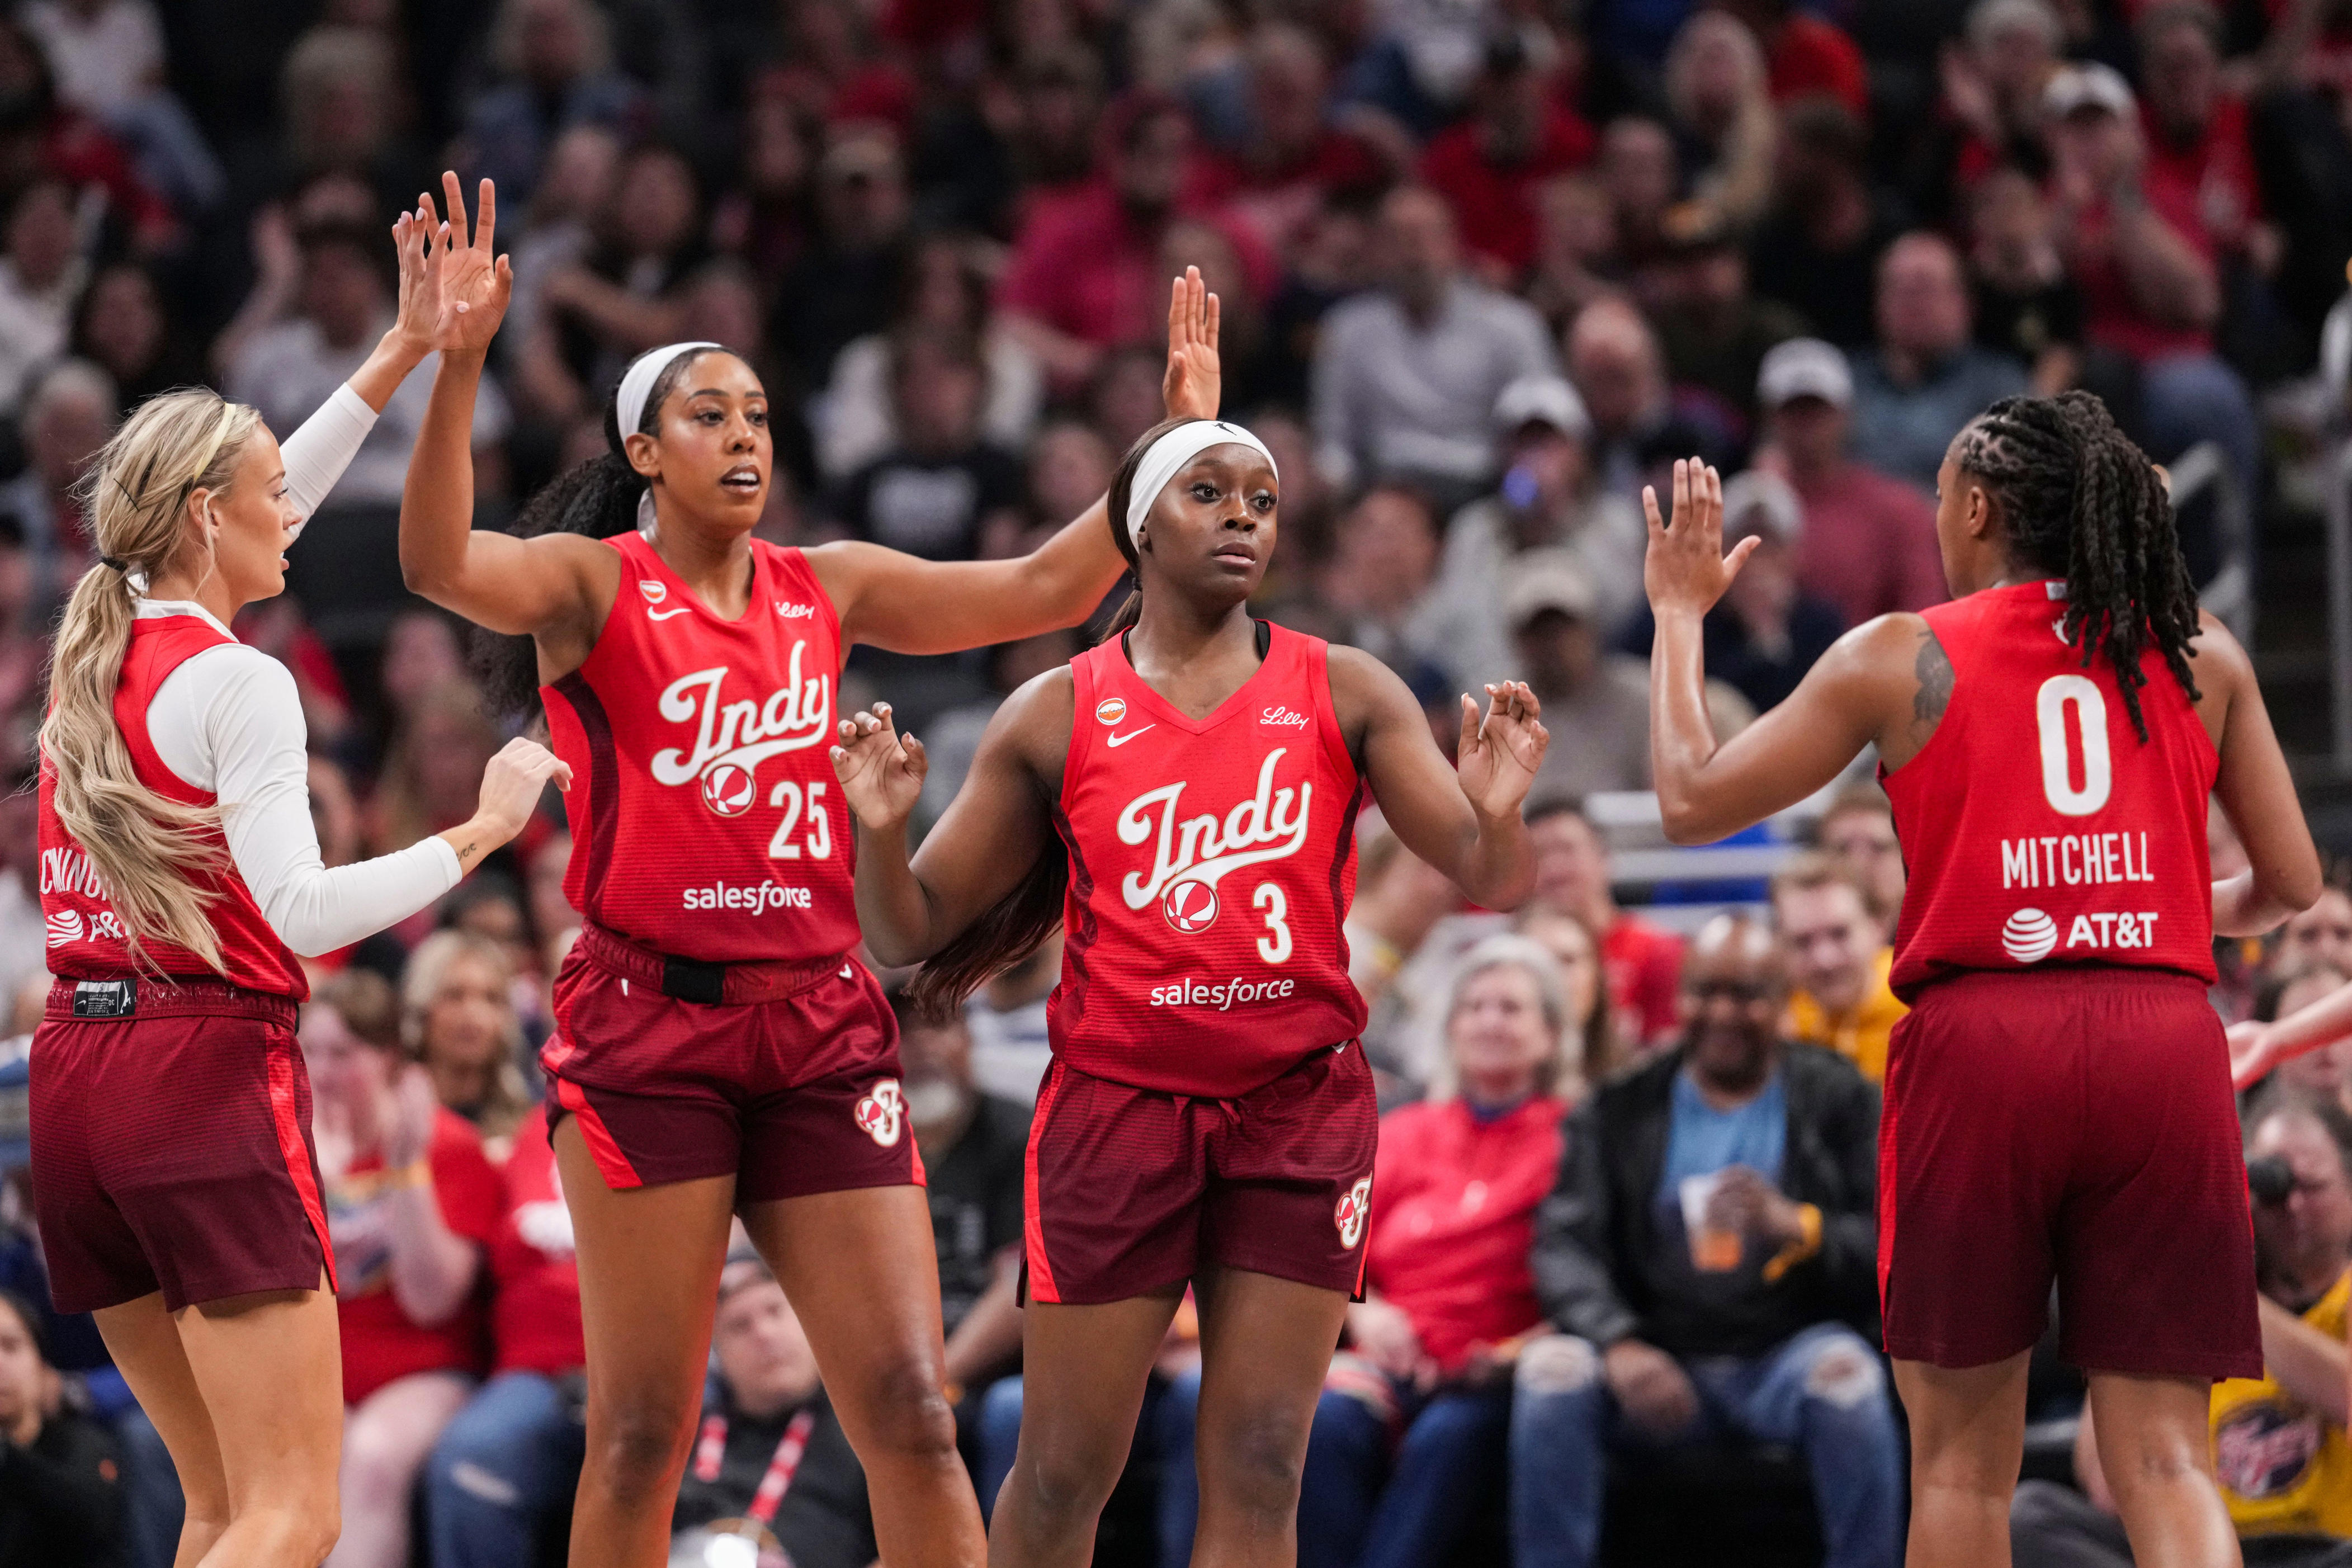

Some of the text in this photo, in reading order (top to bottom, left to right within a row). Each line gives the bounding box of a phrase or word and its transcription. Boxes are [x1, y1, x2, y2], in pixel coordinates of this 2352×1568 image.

[650, 639, 830, 786] Indy
[1259, 706, 1310, 730] Lilly
[2036, 674, 2112, 816] 0
[768, 780, 832, 859] 25
[1116, 747, 1312, 911] Indy
[2000, 831, 2155, 890] MITCHELL
[683, 879, 812, 916] salesforce
[1252, 881, 1293, 964] 3
[2066, 911, 2159, 948] AT&T
[1149, 976, 1295, 1011] salesforce
